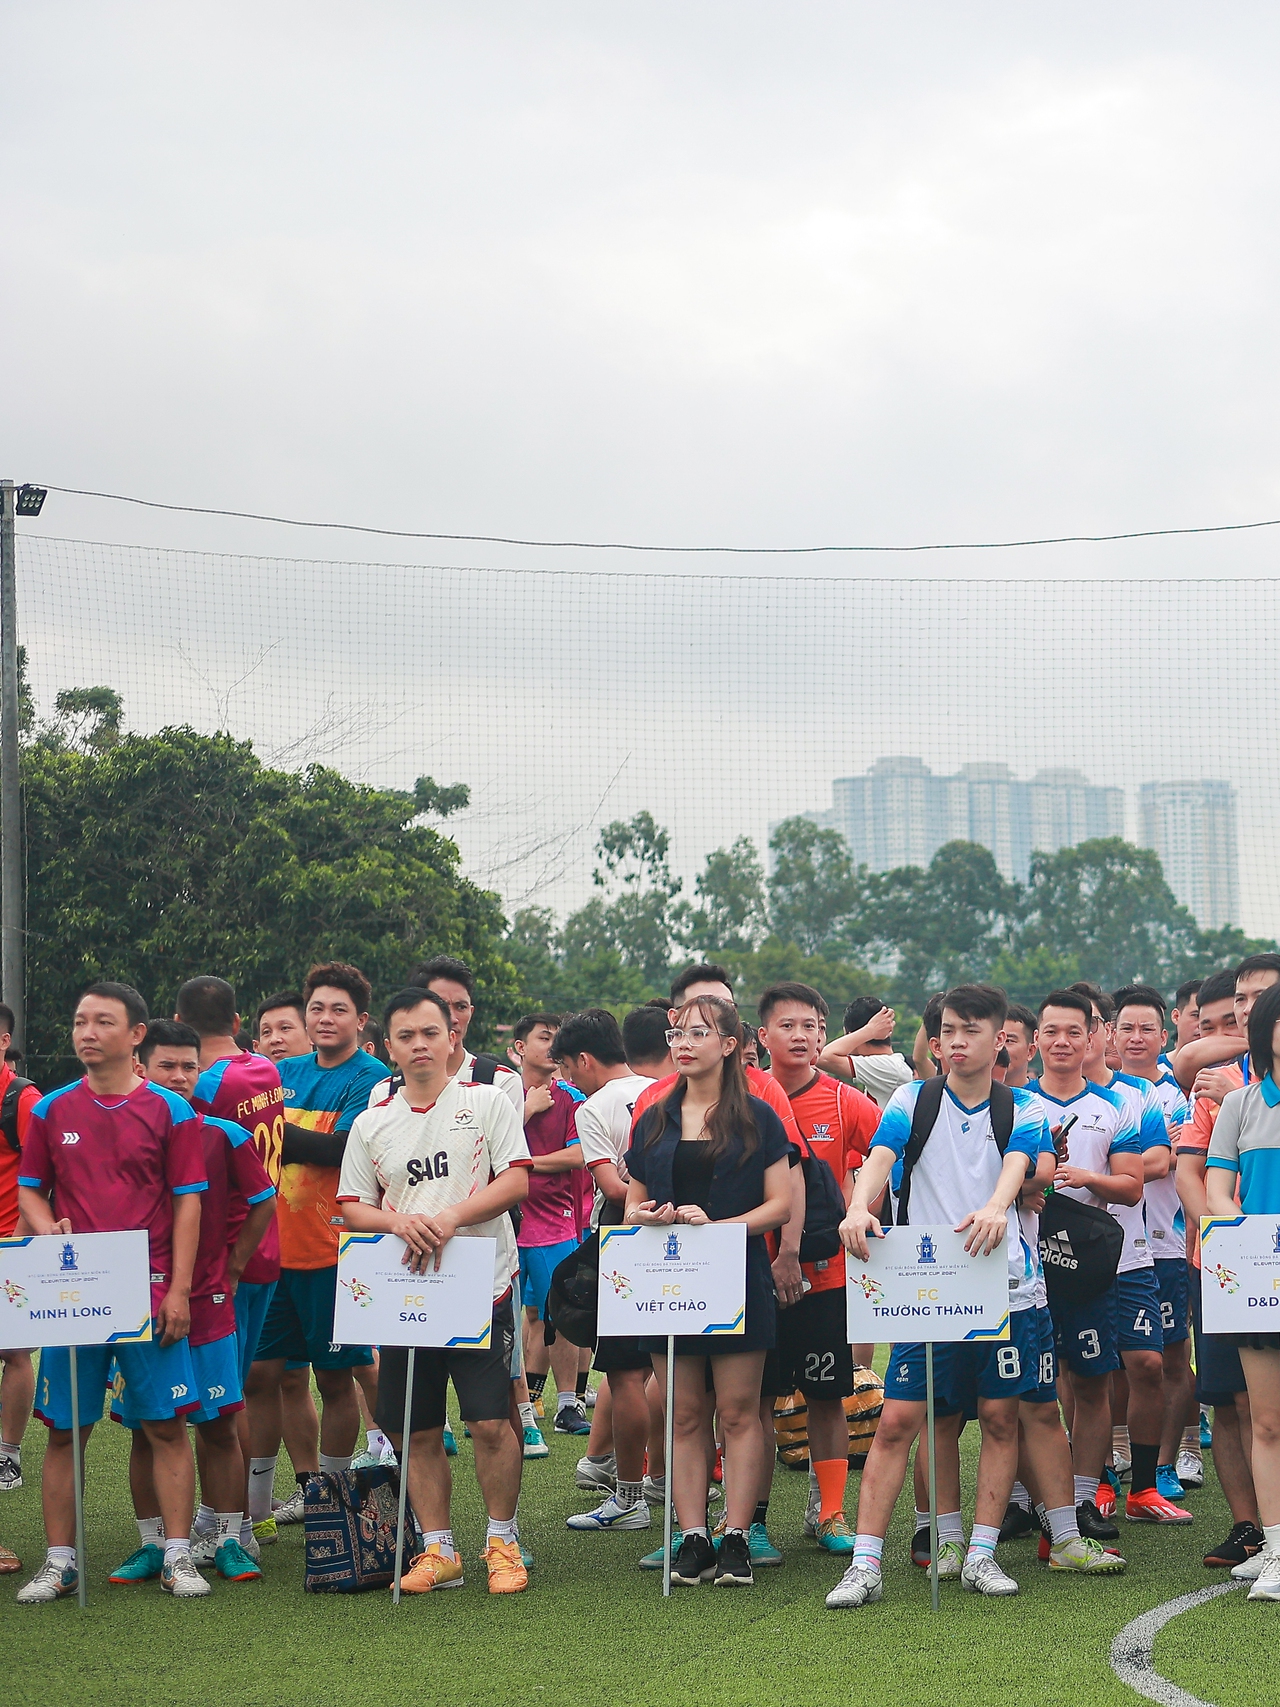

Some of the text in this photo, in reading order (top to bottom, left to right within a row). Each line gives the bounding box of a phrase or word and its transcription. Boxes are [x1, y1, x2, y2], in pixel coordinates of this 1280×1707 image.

[237, 1086, 284, 1118] FC MINH LON
[407, 1151, 448, 1186] SAG
[1040, 1249, 1079, 1270] didas
[60, 1291, 80, 1302] FC
[662, 1285, 681, 1296] FC
[918, 1289, 938, 1300] FC
[404, 1295, 425, 1307] FC
[636, 1299, 706, 1314] VIỆT CHÀO
[1248, 1297, 1279, 1307] D&D
[30, 1306, 112, 1320] MINH LONG
[399, 1312, 427, 1322] SAG
[873, 1303, 984, 1317] TRƯỜNG THÀNH
[1134, 1309, 1152, 1336] 4
[1078, 1328, 1101, 1359] 3
[805, 1352, 835, 1381] 22
[997, 1346, 1021, 1379] 8
